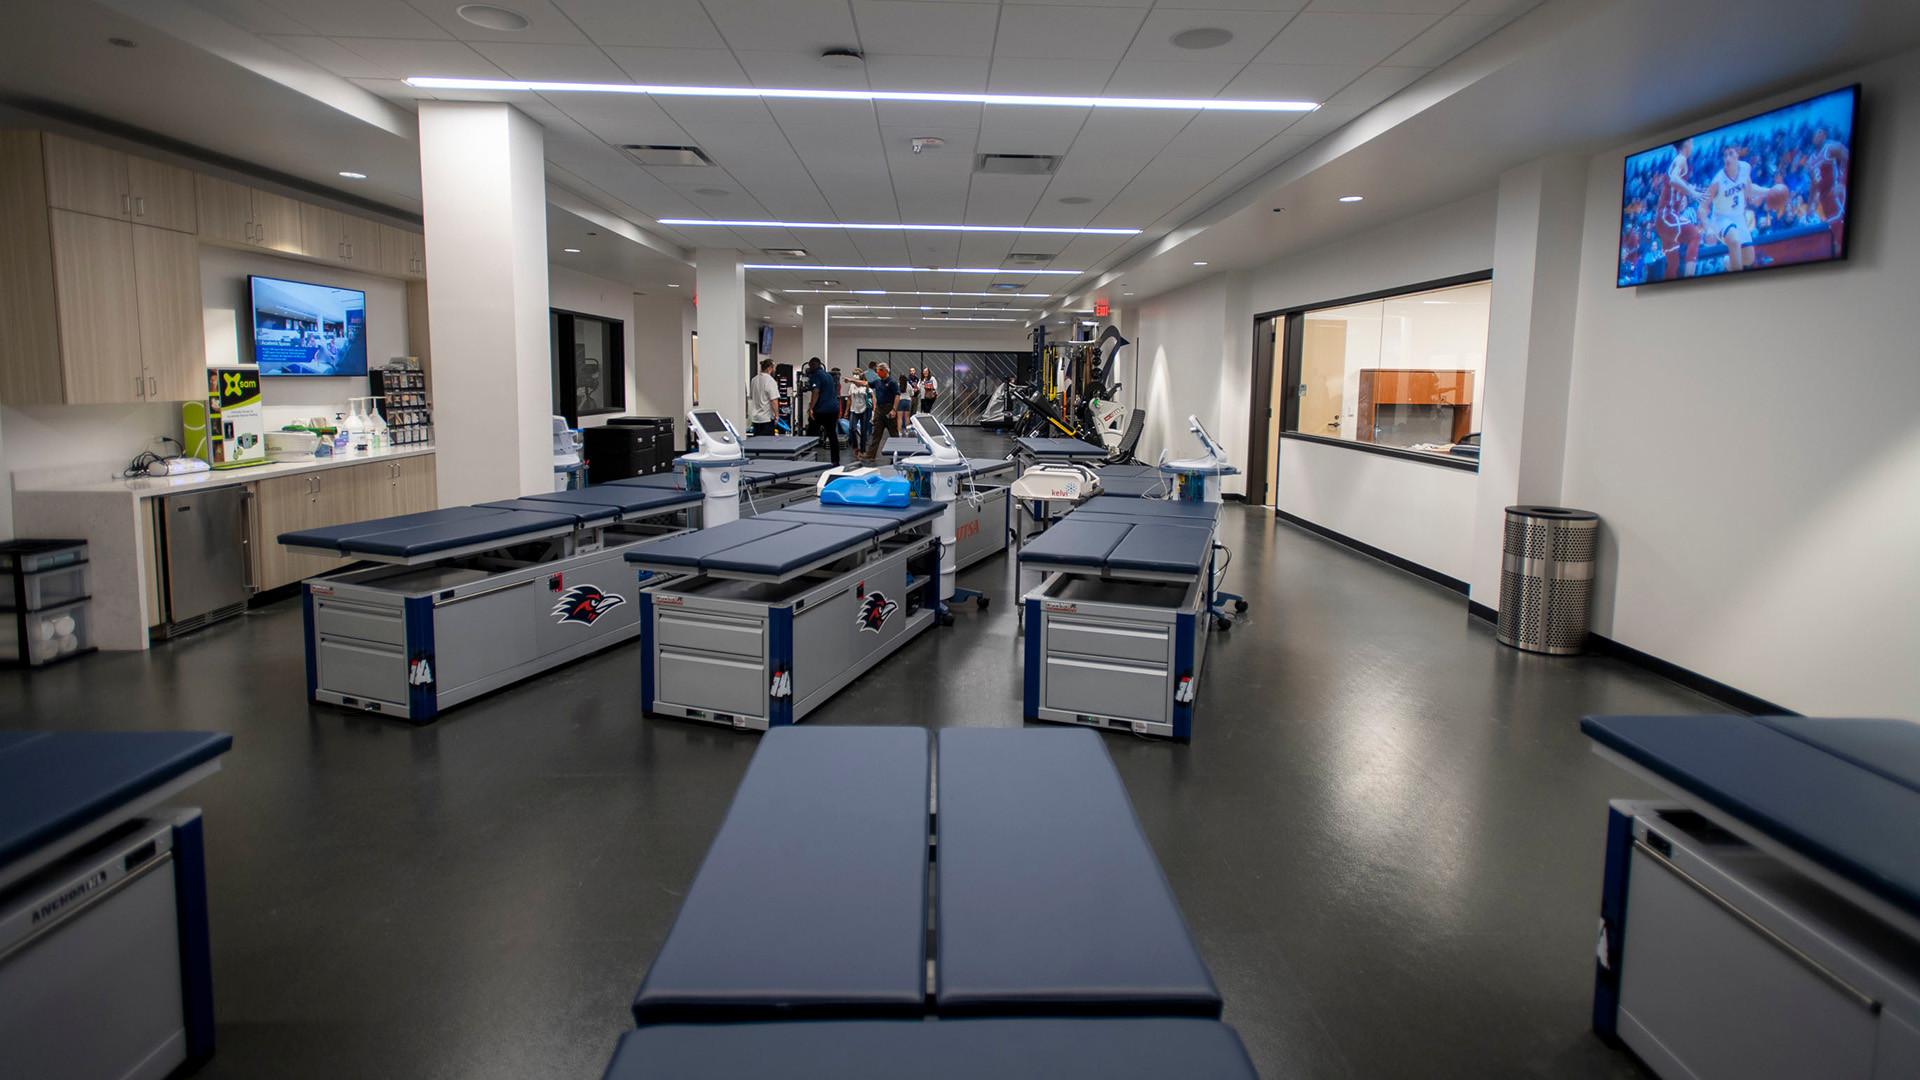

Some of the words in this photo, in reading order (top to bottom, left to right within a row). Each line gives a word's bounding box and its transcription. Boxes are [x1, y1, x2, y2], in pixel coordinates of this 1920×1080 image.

[1696, 256, 1725, 275] TSA
[1096, 306, 1108, 316] EXIT
[239, 380, 257, 388] sam
[955, 519, 979, 542] UTSA
